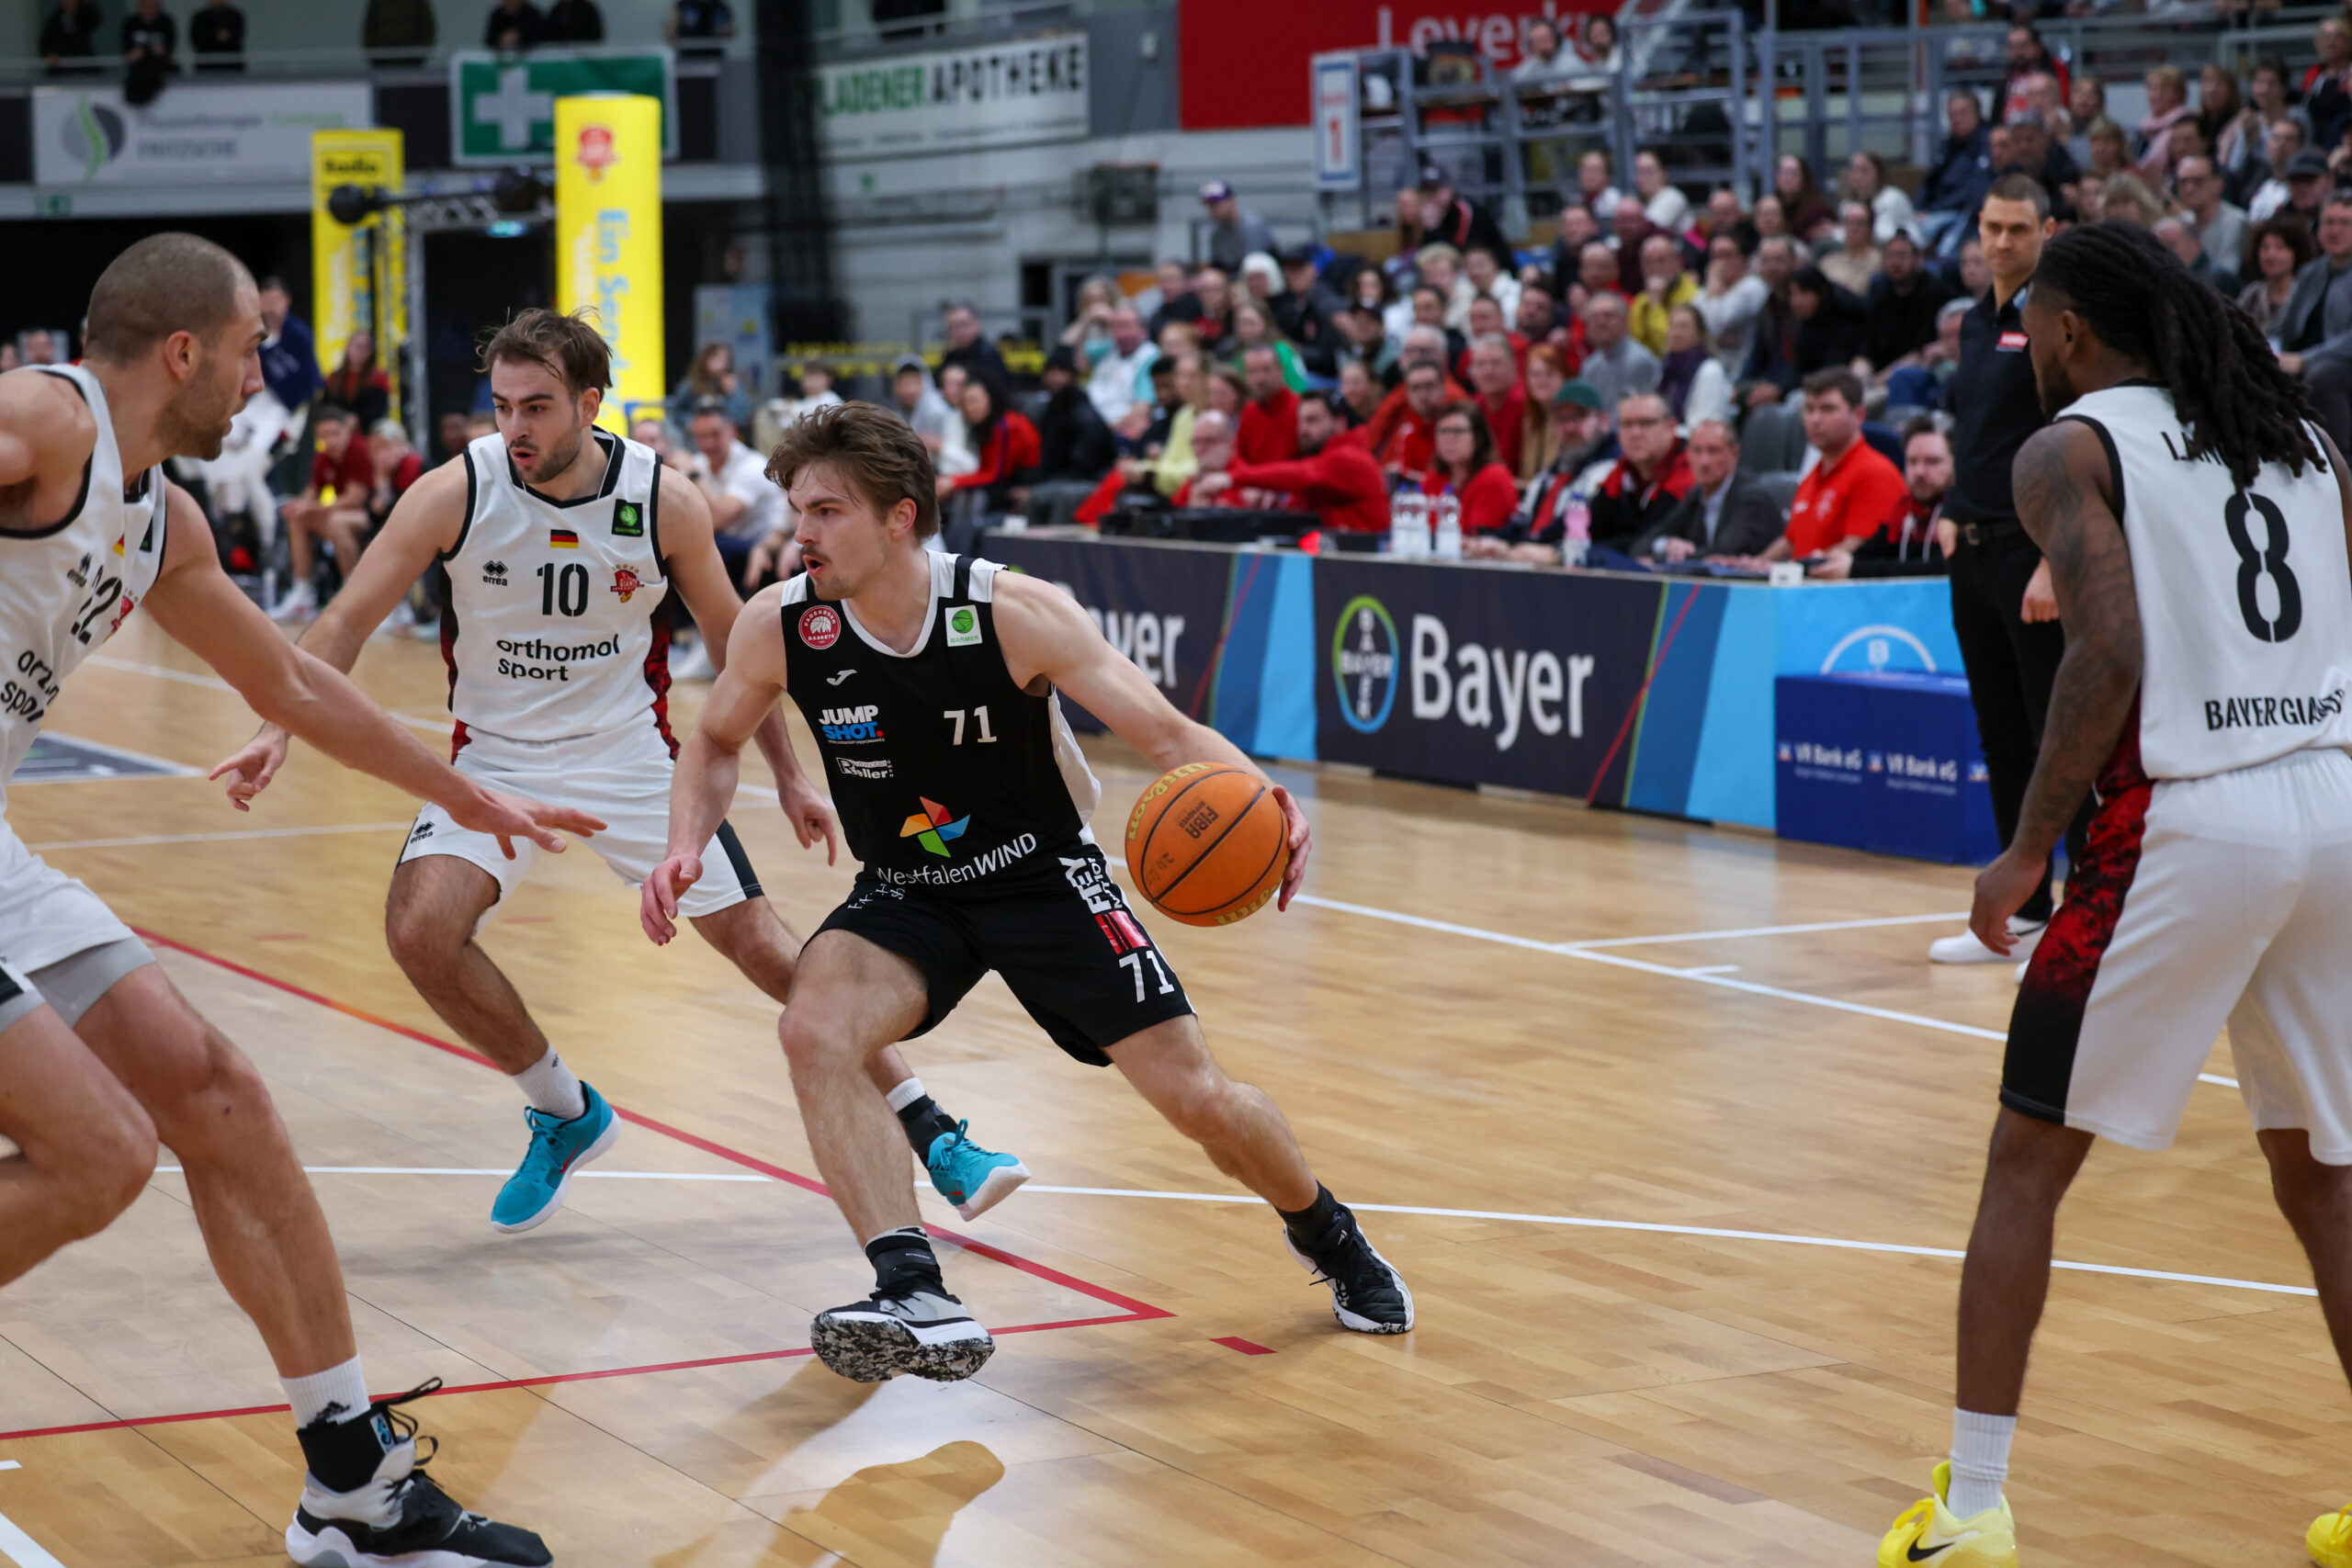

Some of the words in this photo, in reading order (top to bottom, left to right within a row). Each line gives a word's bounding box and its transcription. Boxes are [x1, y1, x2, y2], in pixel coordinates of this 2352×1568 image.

[932, 44, 1083, 103] APOTHEKE
[1328, 119, 1342, 164] 1
[597, 209, 630, 264] Ein
[482, 575, 508, 586] errea
[2224, 492, 2302, 643] 8
[537, 563, 589, 617] 10
[804, 610, 836, 626] PADERBORN
[496, 634, 620, 661] orthomol
[950, 635, 979, 643] BARMER
[498, 658, 569, 681] sport
[1411, 614, 1594, 751] Bayer
[818, 705, 879, 725] JUMP
[944, 705, 998, 746] 71
[2205, 697, 2278, 730] BAYER
[822, 721, 885, 740] SHOT.
[1794, 742, 1811, 763] VR
[1814, 744, 1842, 768] Bank
[1845, 749, 1862, 771] eG
[1886, 753, 1903, 774] VR
[1905, 755, 1937, 779] Bank
[1939, 760, 1958, 782] eG
[1179, 800, 1206, 829] APPROVED
[1184, 806, 1219, 840] FIBA
[1118, 950, 1175, 1003] 71
